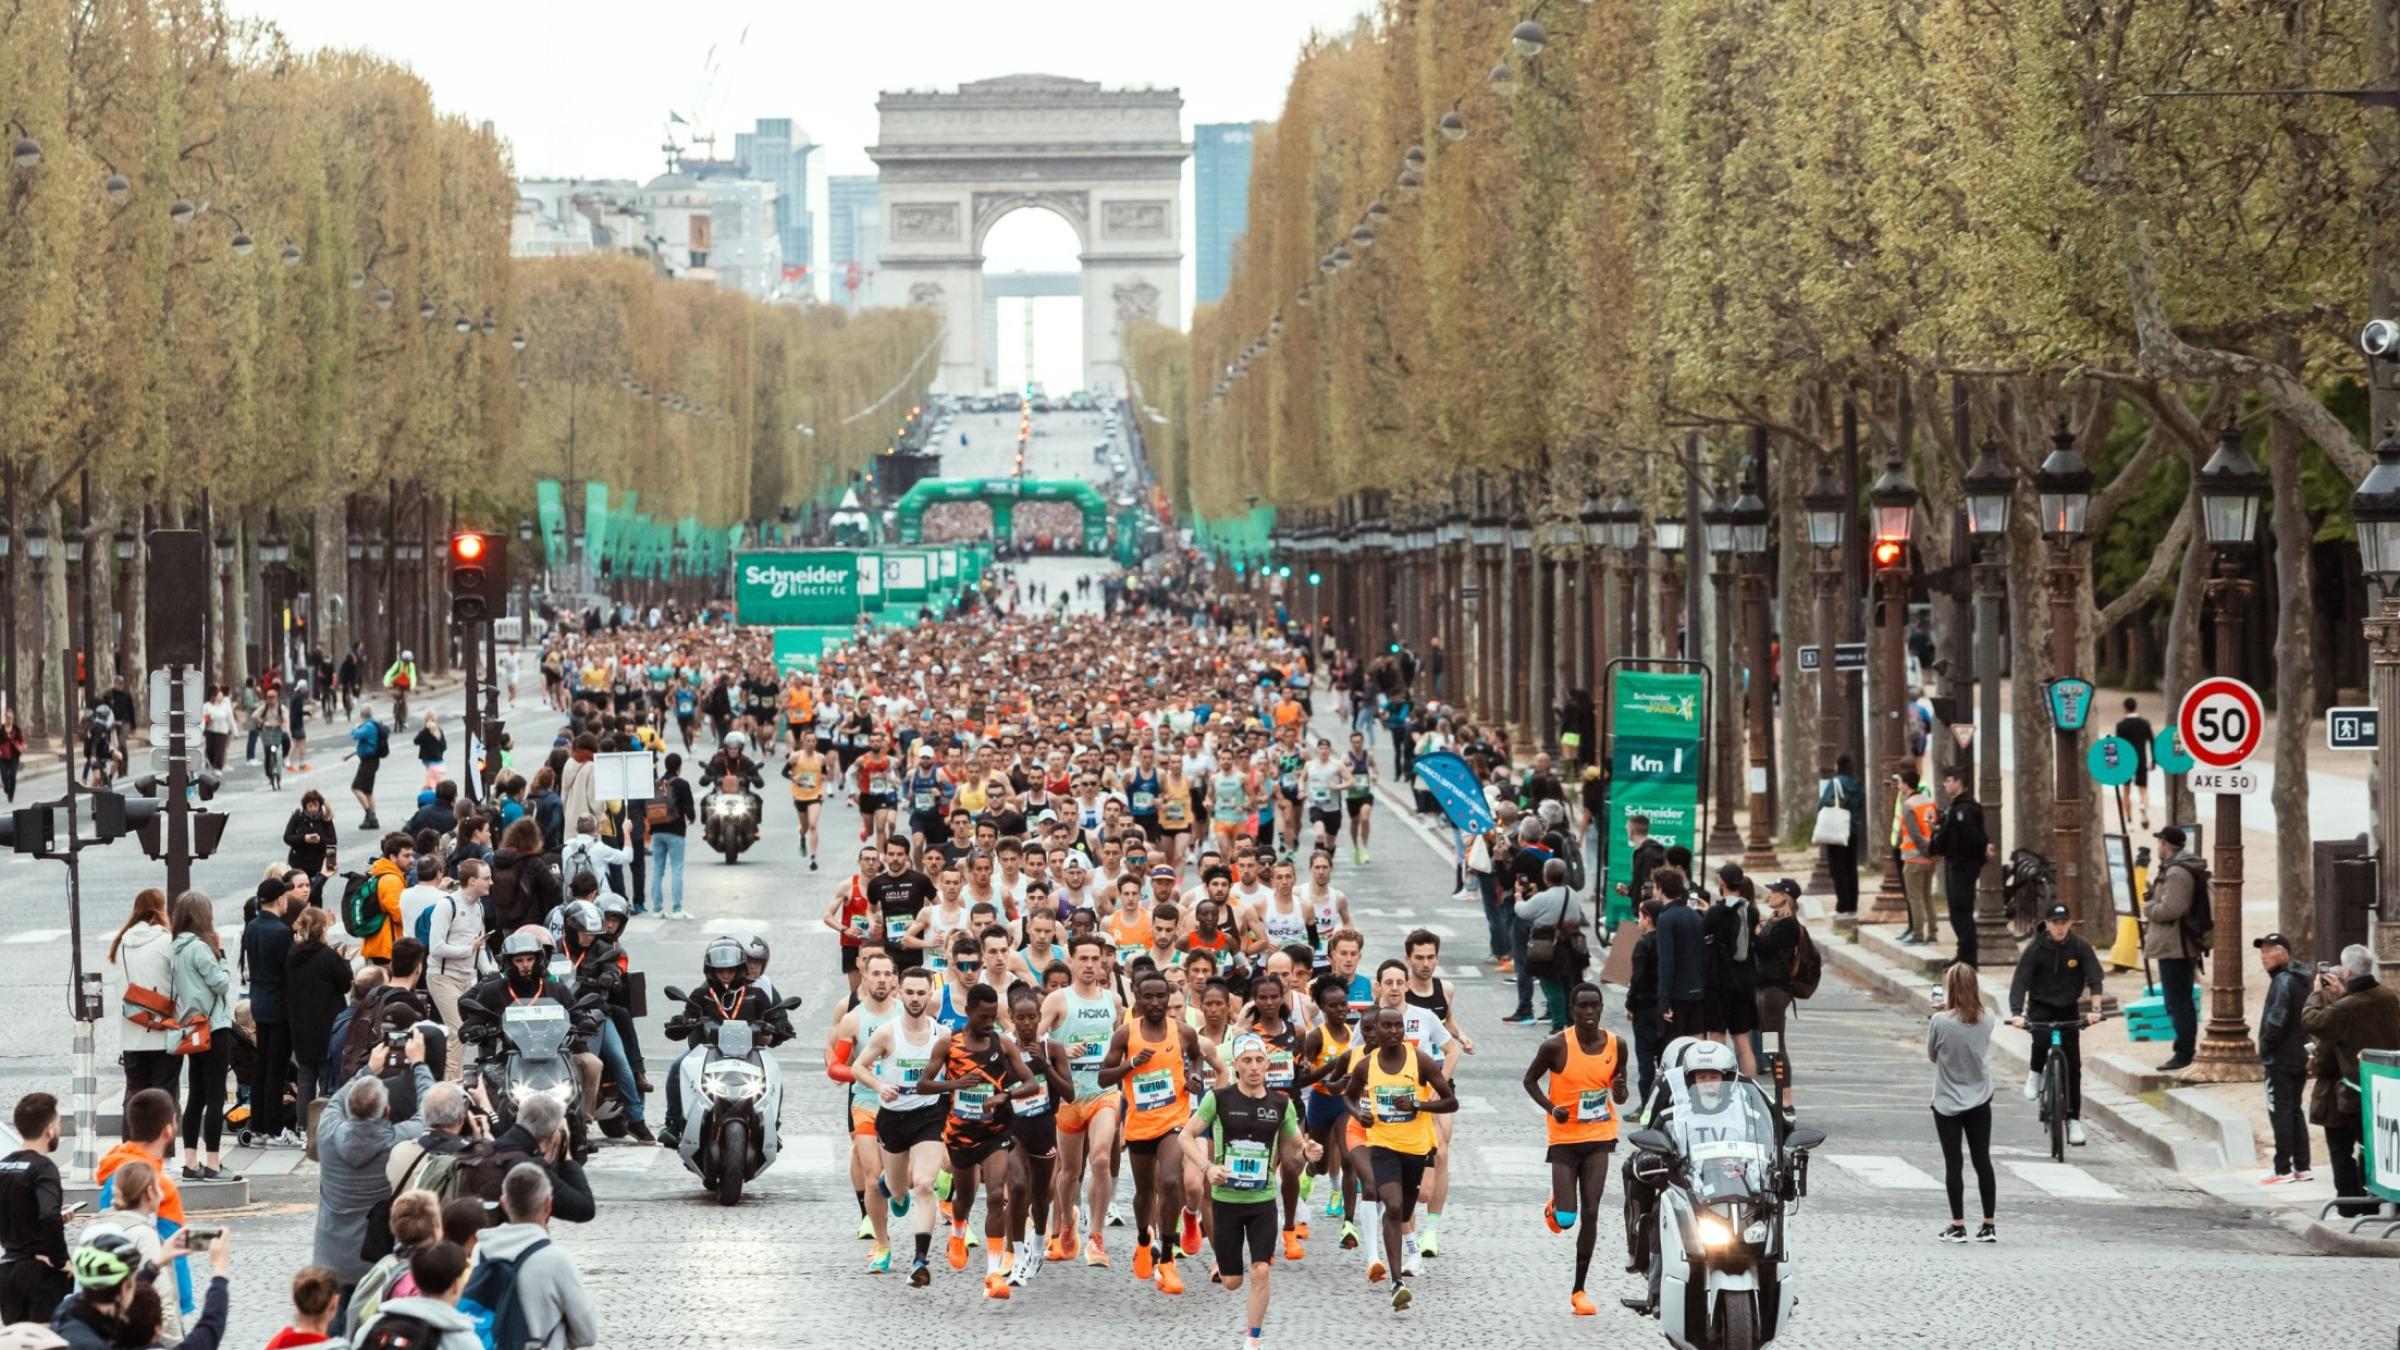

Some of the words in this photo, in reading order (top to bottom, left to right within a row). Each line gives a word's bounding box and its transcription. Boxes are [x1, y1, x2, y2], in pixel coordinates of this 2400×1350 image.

[745, 565, 848, 586] Schneider
[789, 583, 846, 596] Electric
[2198, 707, 2246, 743] 50
[1630, 754, 1664, 773] Km
[1673, 747, 1683, 773] 1
[2194, 775, 2222, 787] AXE
[2231, 776, 2249, 788] 50
[1625, 804, 1685, 818] Schneider
[1078, 1008, 1110, 1019] HOKA
[1695, 1126, 1727, 1143] TV
[1239, 1159, 1255, 1172] 114
